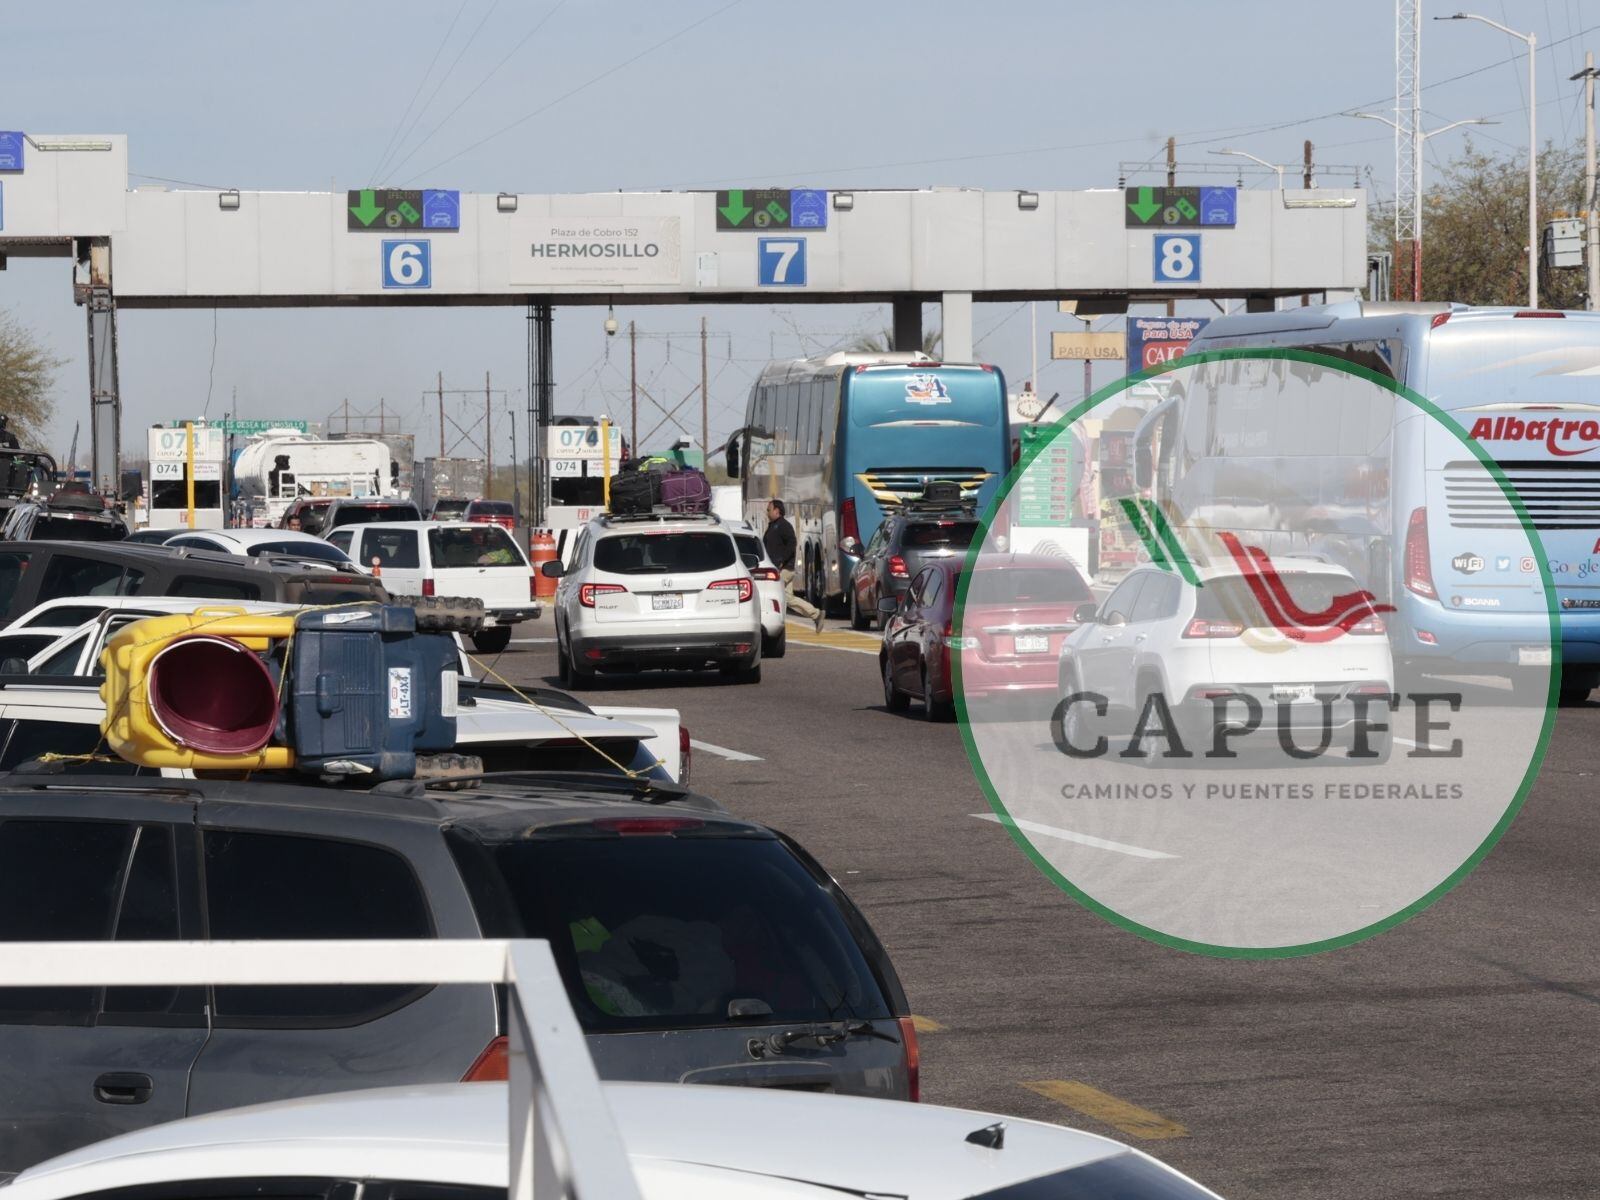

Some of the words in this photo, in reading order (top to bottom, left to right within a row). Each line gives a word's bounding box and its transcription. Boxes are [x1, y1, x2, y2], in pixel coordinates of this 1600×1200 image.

[551, 228, 576, 237] Plaza
[578, 228, 591, 237] de
[593, 228, 622, 237] Cobro
[624, 229, 639, 237] 152
[531, 243, 660, 258] HERMOSILLO
[389, 243, 423, 285] 6
[765, 242, 799, 282] 7
[1161, 237, 1194, 279] 8
[1142, 329, 1169, 340] para
[1169, 328, 1194, 339] USA
[1058, 346, 1090, 358] PARA
[1093, 346, 1119, 358] USA
[561, 430, 598, 447] 074
[156, 464, 178, 473] 074
[556, 462, 576, 470] 074
[1547, 559, 1599, 578] Google
[1464, 598, 1500, 606] SCANIA
